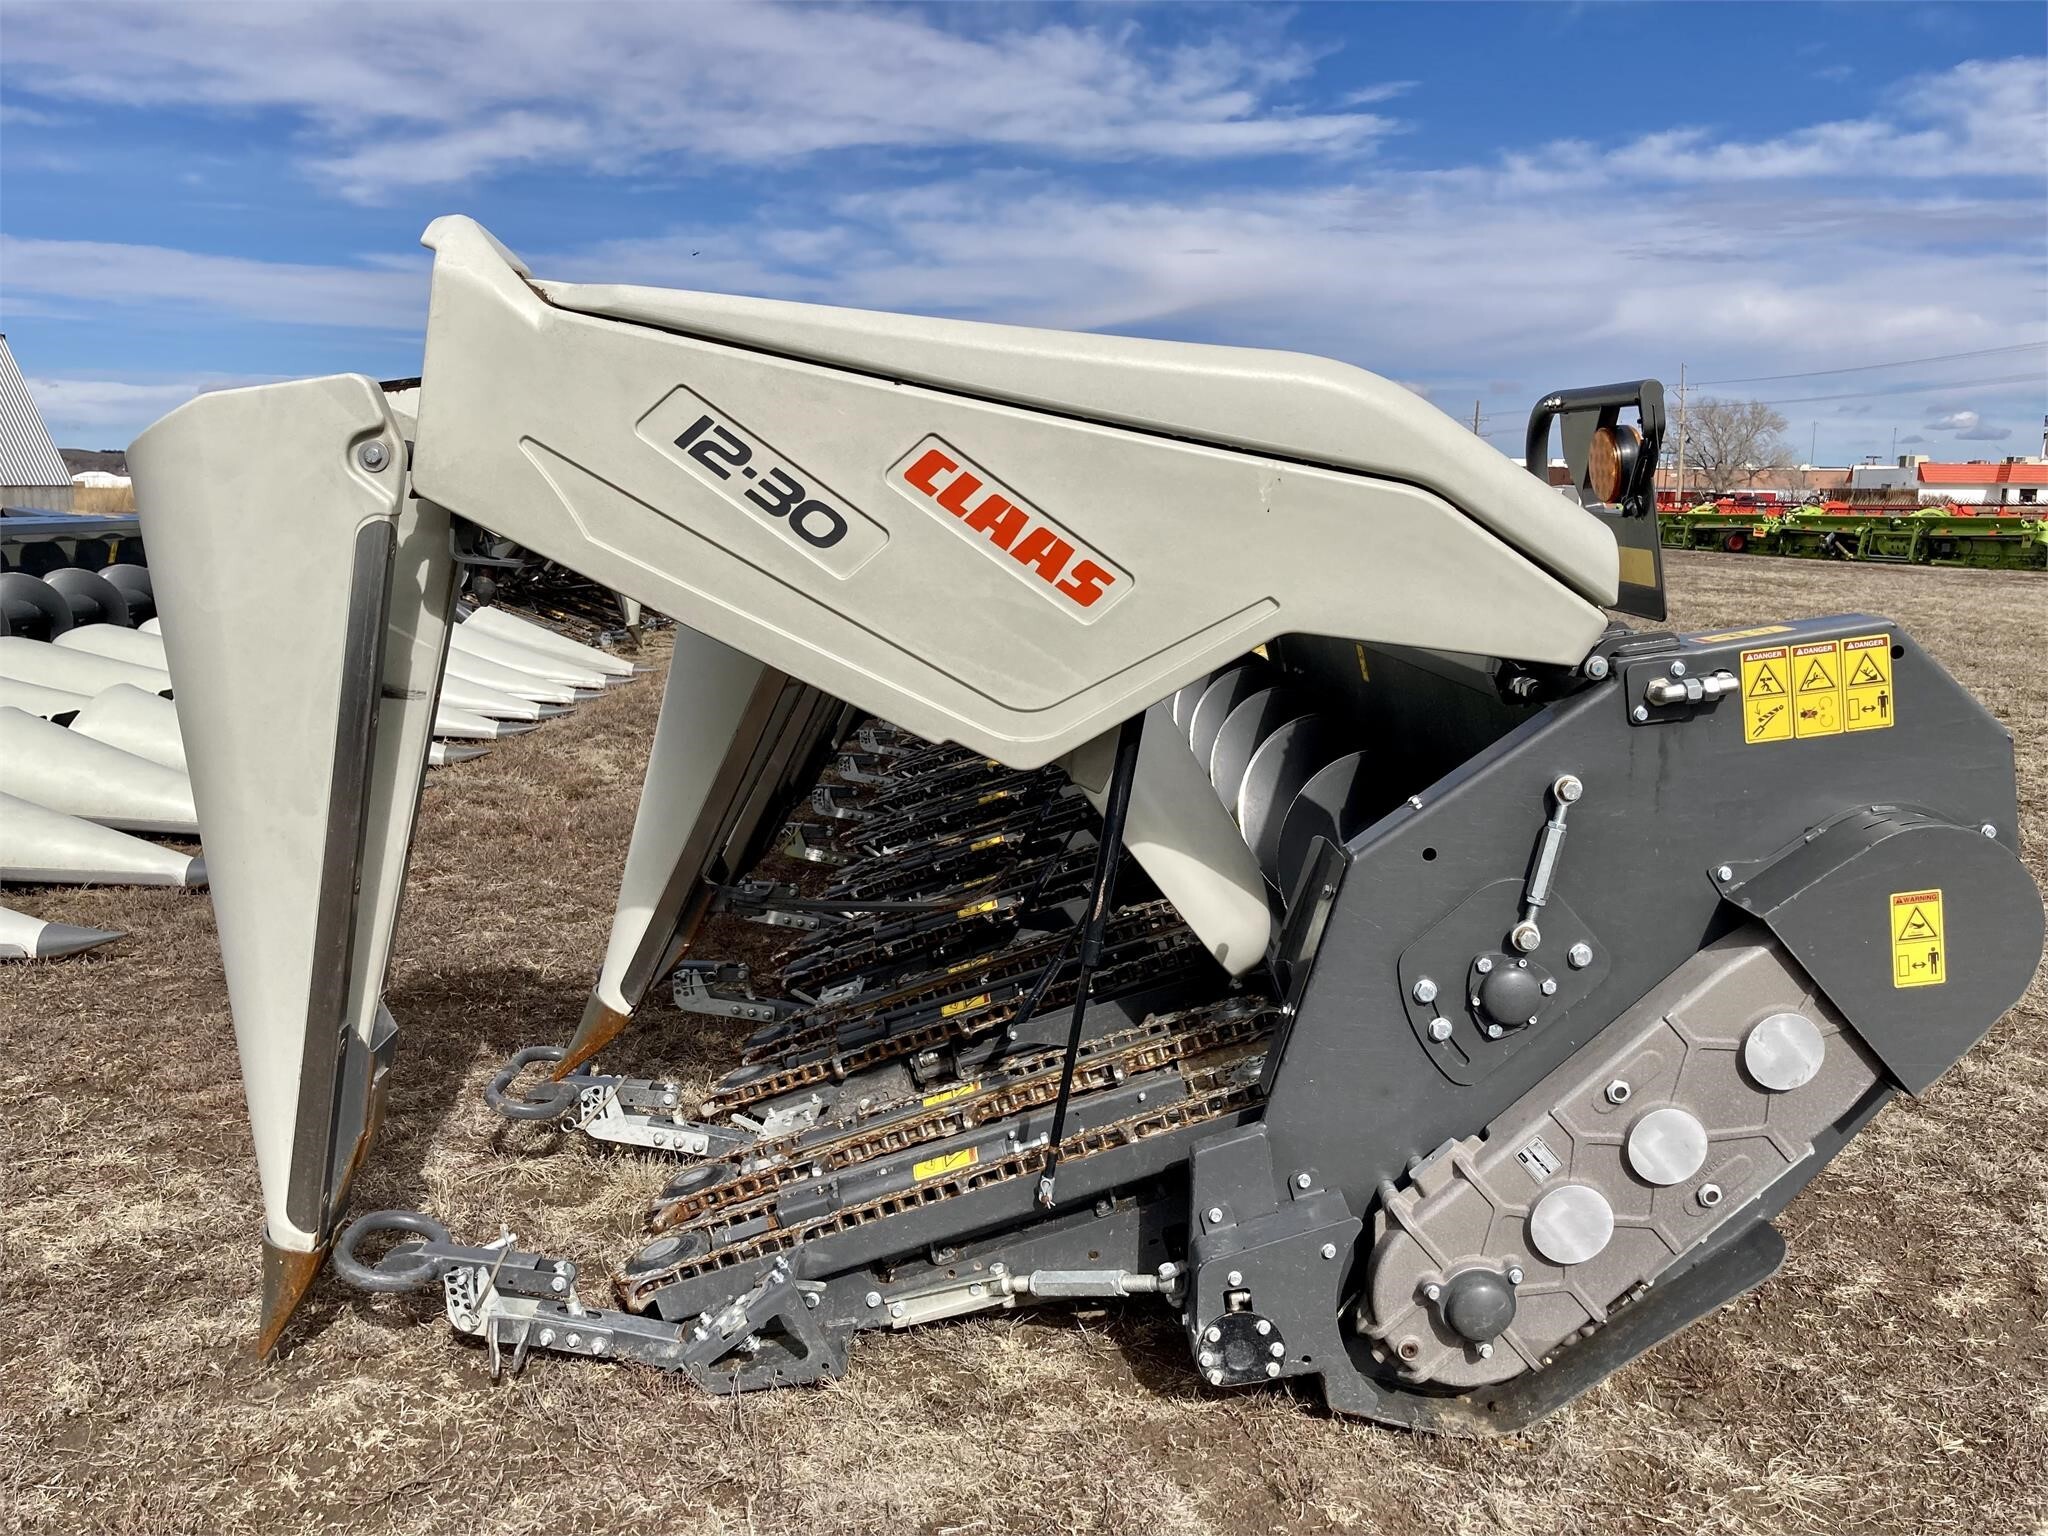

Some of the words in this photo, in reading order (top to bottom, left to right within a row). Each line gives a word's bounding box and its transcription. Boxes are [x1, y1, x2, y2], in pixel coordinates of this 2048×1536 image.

[903, 448, 1117, 608] CLAAS
[1854, 639, 1884, 649] DANGER
[1802, 645, 1833, 654] DANGER
[1753, 650, 1782, 660] DANGER
[1903, 893, 1937, 903] WARNING
